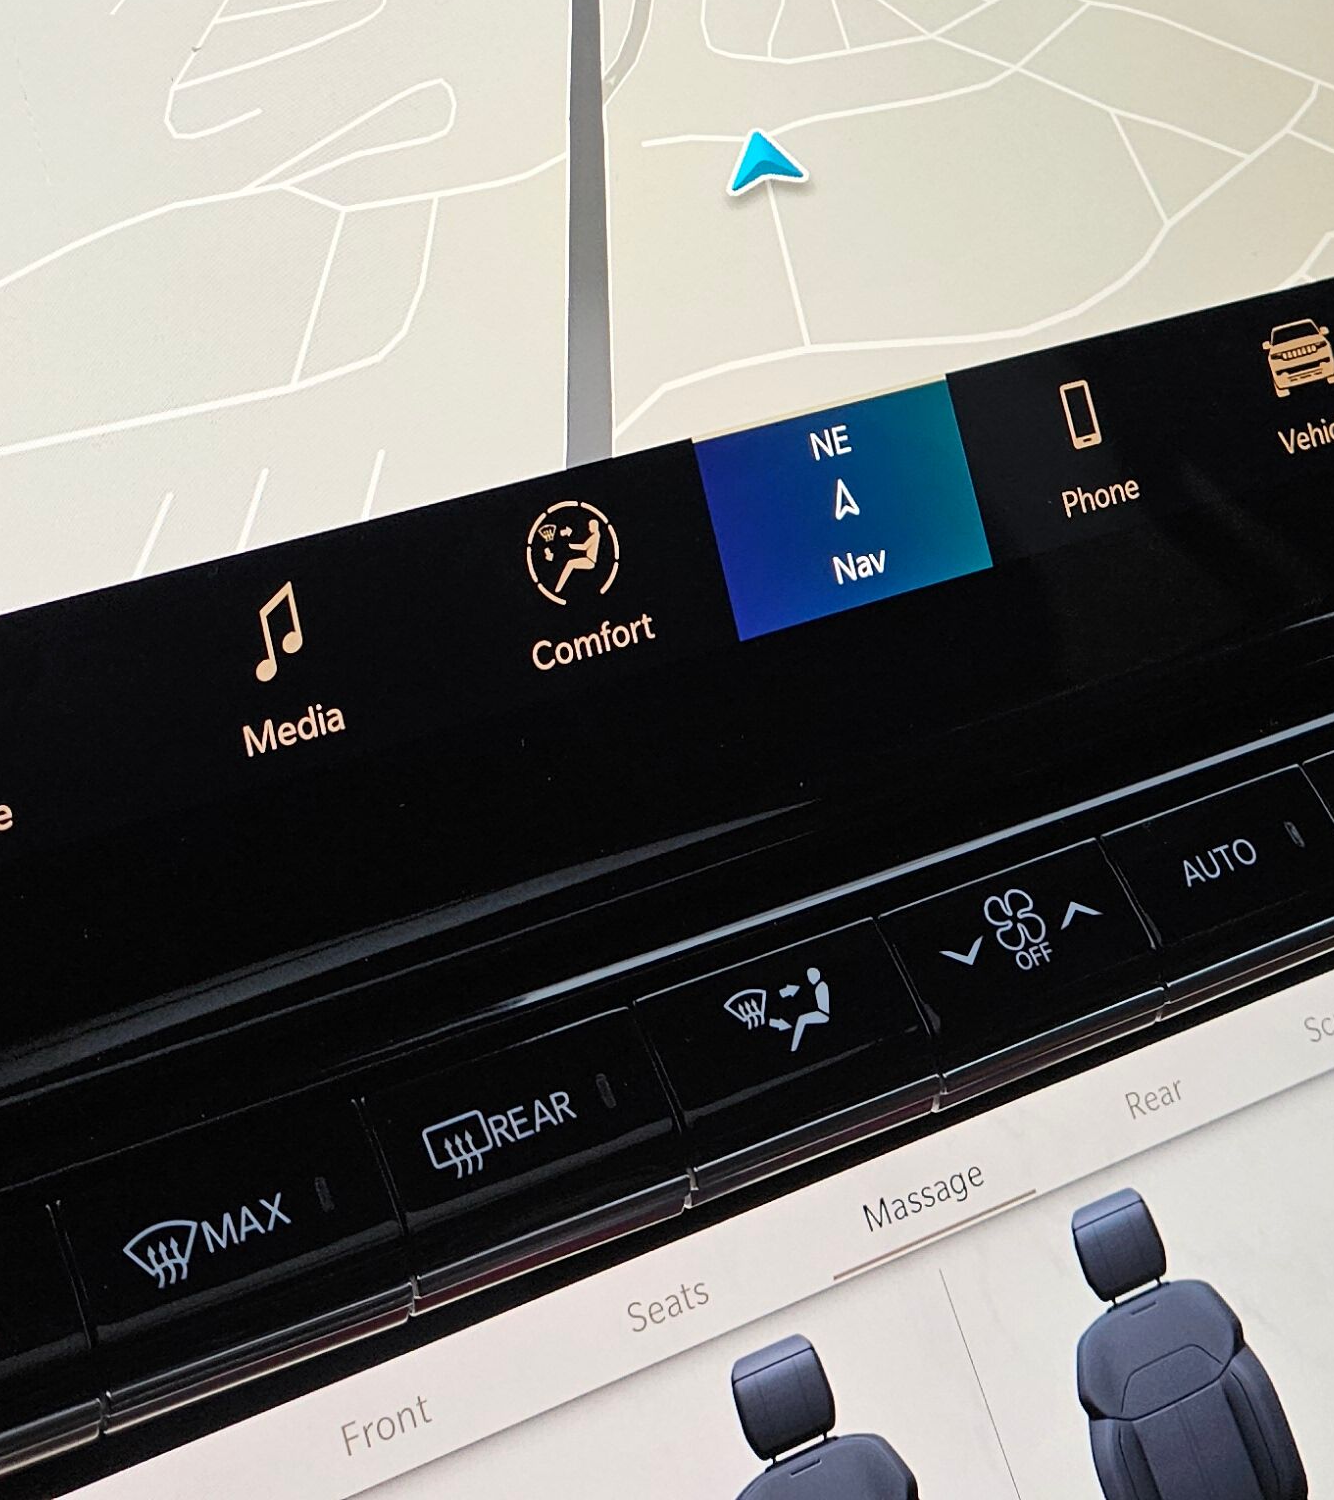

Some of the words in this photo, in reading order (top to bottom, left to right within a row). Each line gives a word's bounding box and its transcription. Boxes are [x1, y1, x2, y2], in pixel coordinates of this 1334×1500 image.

[810, 425, 853, 461] NE
[1061, 477, 1141, 518] Phone
[833, 550, 887, 585] Nav
[532, 613, 656, 671] Comfort
[242, 703, 347, 758] Media
[1181, 838, 1257, 888] AUTO
[1014, 941, 1054, 971] OFF
[488, 1091, 578, 1149] REAR
[1125, 1078, 1182, 1119] Rear
[200, 1192, 292, 1255] MAX
[862, 1164, 985, 1232] Massage
[626, 1281, 711, 1334] Seats
[340, 1394, 433, 1457] Front
